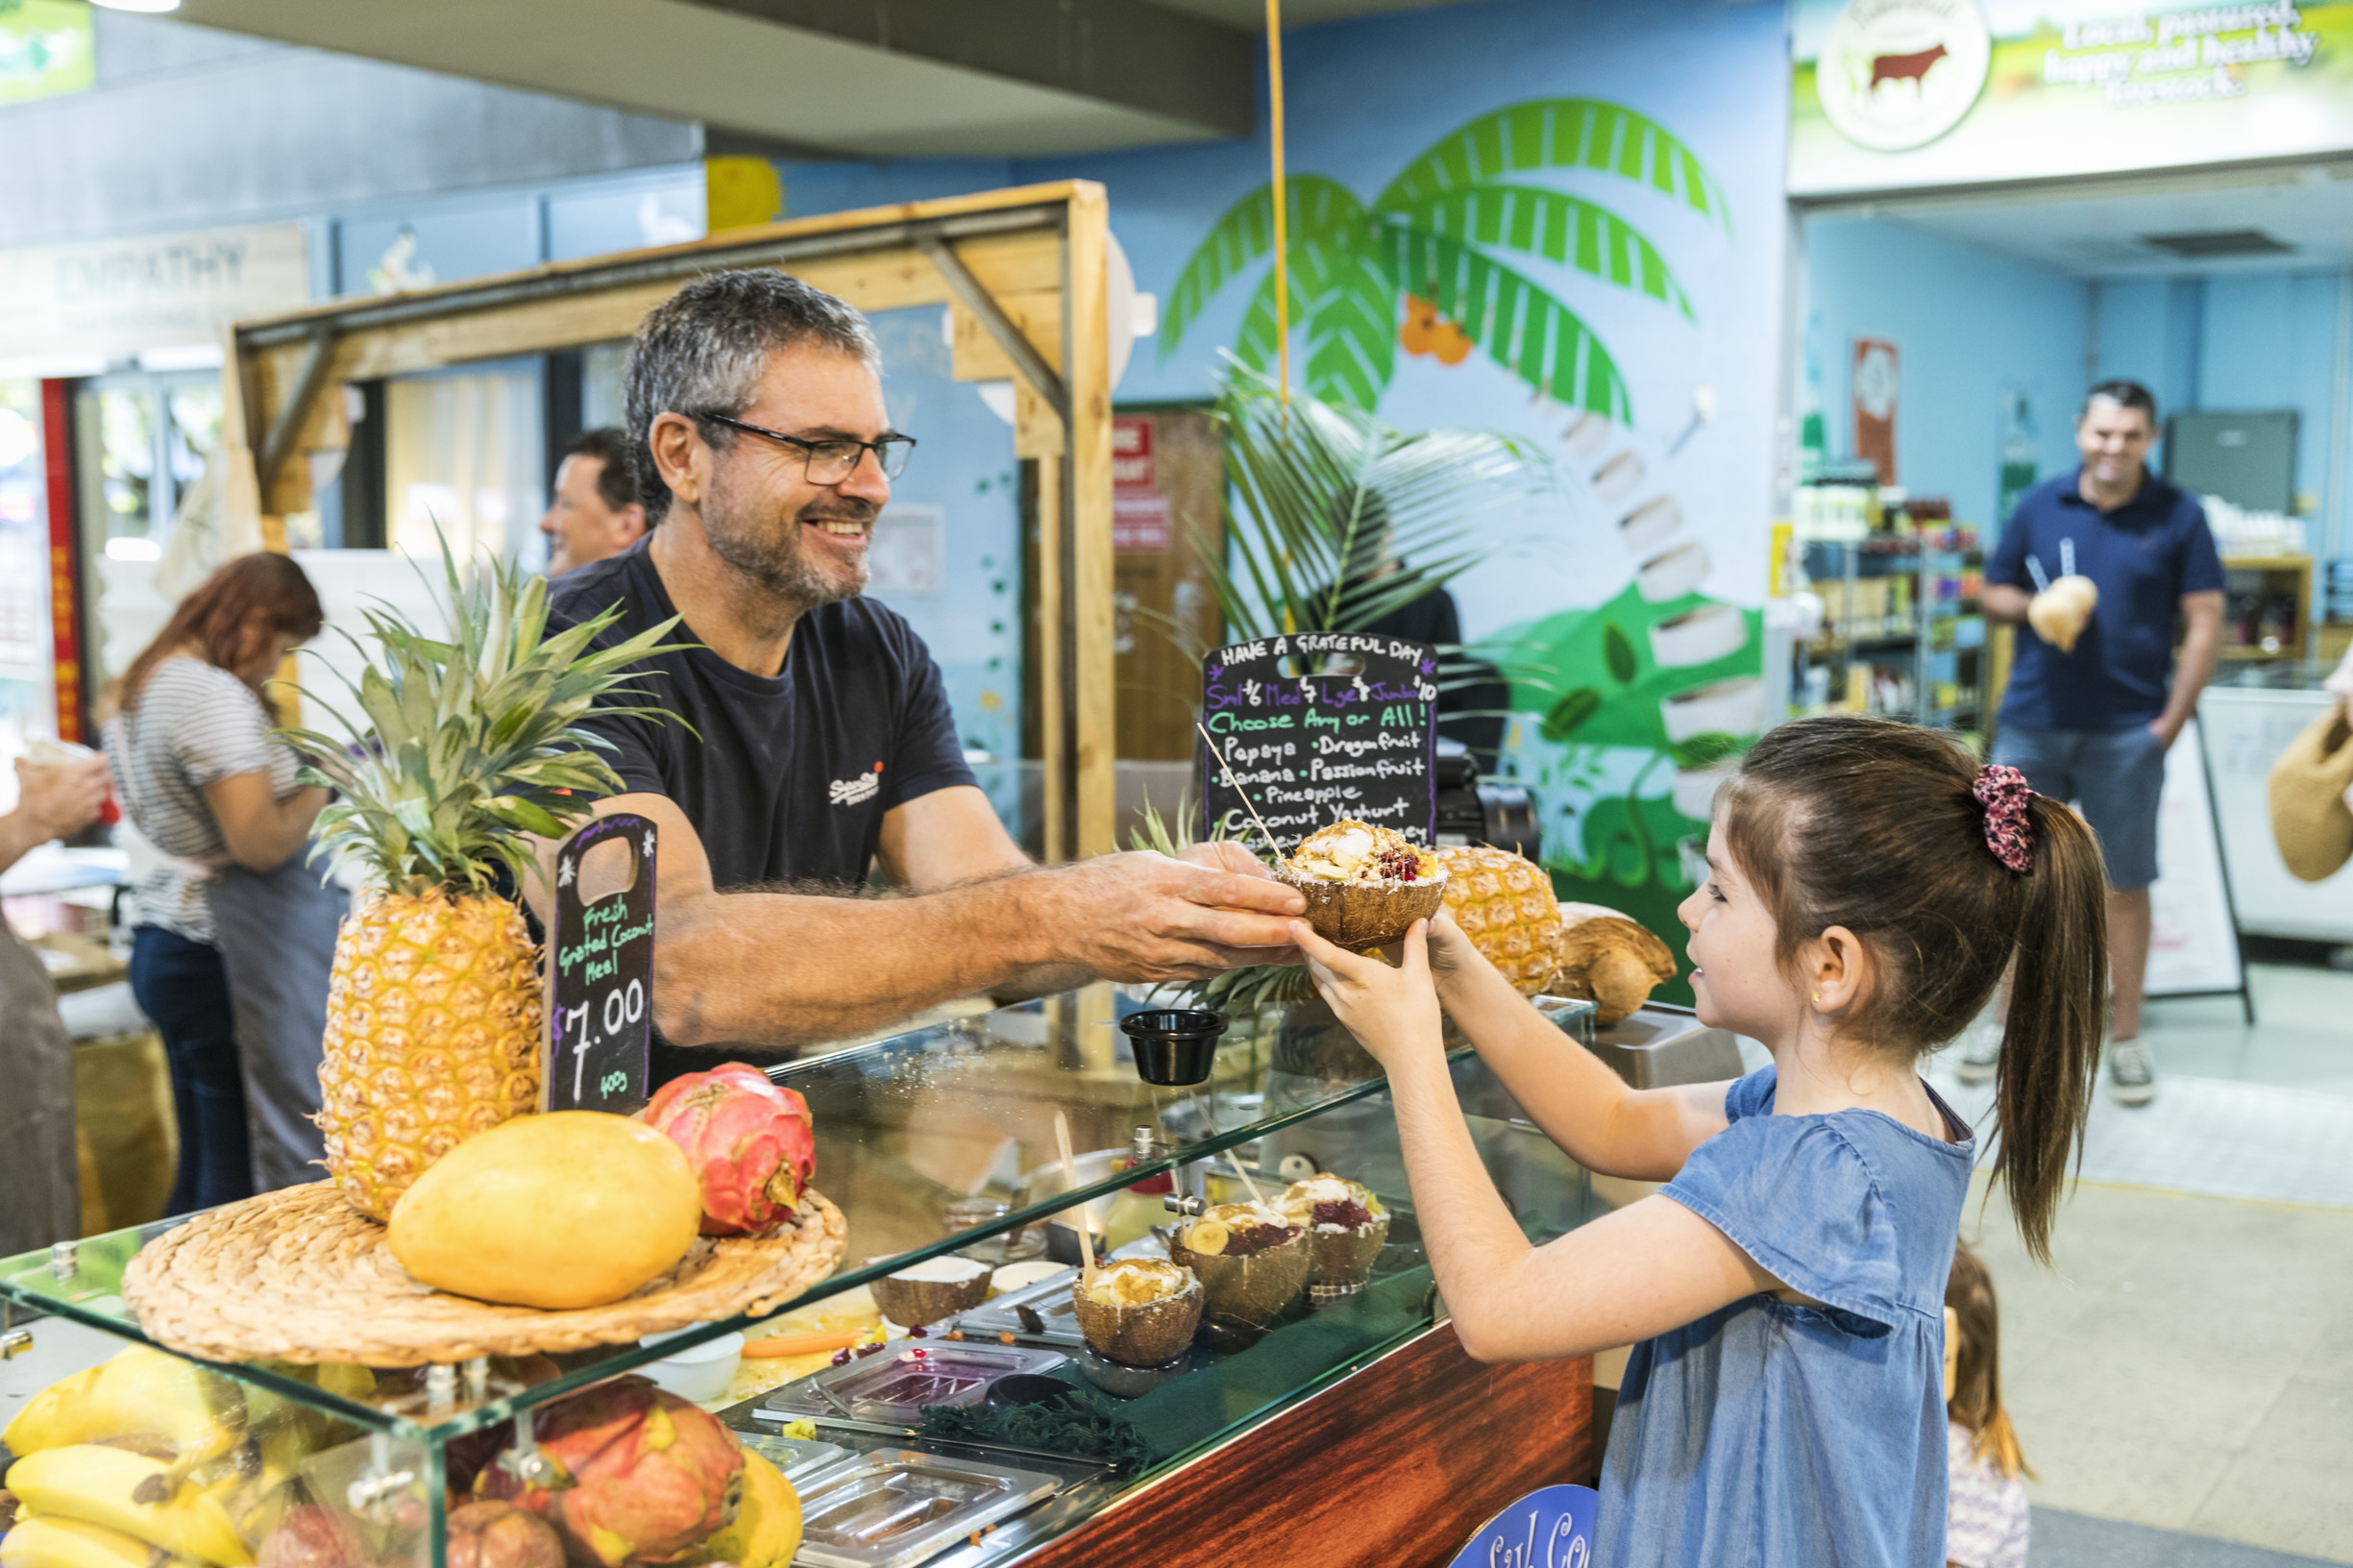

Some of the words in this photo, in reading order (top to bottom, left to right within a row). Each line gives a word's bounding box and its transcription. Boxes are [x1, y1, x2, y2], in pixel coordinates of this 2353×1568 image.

[2138, 36, 2198, 73] and
[55, 238, 247, 302] EMPATHY
[1220, 641, 1267, 666] HAVE
[1273, 635, 1288, 655] A
[1296, 634, 1386, 654] GRATEFUL
[1389, 641, 1423, 667] DAY
[1207, 683, 1242, 709] Sml
[1265, 683, 1300, 707] Med
[1322, 682, 1359, 708] Lge
[1370, 680, 1418, 702] Jumbo
[1208, 711, 1295, 734] Choose
[1304, 707, 1340, 734] Any
[1346, 714, 1370, 725] or
[1224, 736, 1296, 767] Papaya
[1318, 730, 1421, 757] Dragonfruit
[1219, 767, 1296, 788] Banana
[1311, 757, 1426, 782] Passionfruit
[1265, 784, 1362, 805] Pineapple
[1224, 804, 1319, 831] Coconut
[583, 894, 627, 932] Fresh
[559, 927, 607, 976] Grated
[585, 949, 618, 986] Meal
[600, 1070, 627, 1099] 400g
